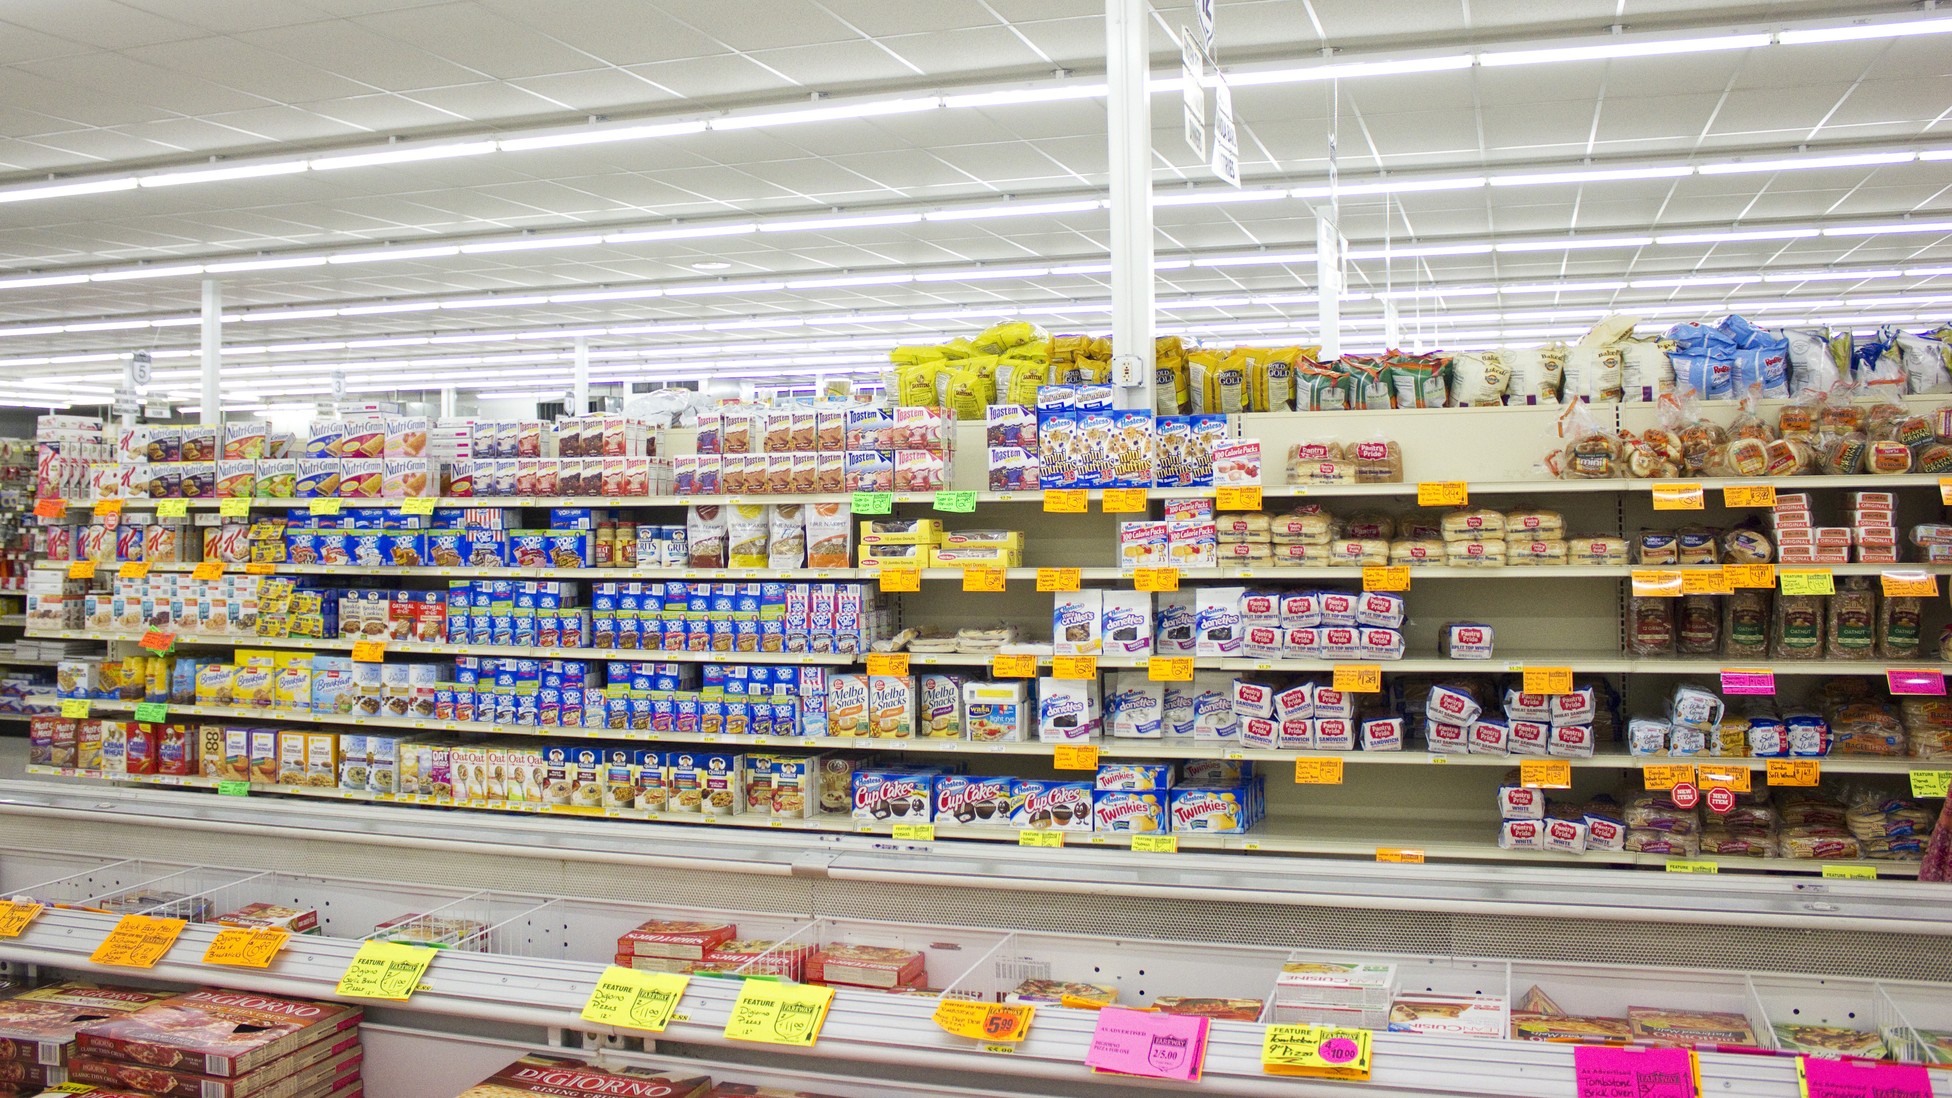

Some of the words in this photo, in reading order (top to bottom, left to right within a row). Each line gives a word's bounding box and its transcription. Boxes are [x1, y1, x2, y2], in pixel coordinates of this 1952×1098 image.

[138, 366, 146, 378] 5
[1268, 368, 1291, 377] GOLD
[1065, 375, 1083, 383] GOLD
[1220, 377, 1243, 386] GOLD
[1046, 420, 1070, 432] Hostess
[1084, 419, 1109, 430] Hostess
[1122, 417, 1146, 429] Hostess
[1161, 424, 1185, 436] Hostess
[1045, 450, 1066, 463] mini
[1082, 449, 1103, 463] mini
[1119, 449, 1141, 463] mini
[1160, 453, 1181, 466] mini
[1214, 452, 1225, 460] 100
[1225, 449, 1242, 458] Calorie
[1041, 460, 1076, 475] muffins
[1078, 460, 1114, 474] muffins
[1115, 459, 1152, 474] muffins
[1157, 463, 1191, 478] muffins
[1169, 505, 1179, 513] 100
[1178, 503, 1195, 512] Calorie
[1123, 533, 1132, 541] 100
[1132, 530, 1149, 539] Calorie
[1171, 533, 1181, 541] 100
[1180, 530, 1198, 539] Calorie
[1371, 599, 1389, 607] Pantry
[1371, 603, 1387, 611] Pride
[1107, 615, 1144, 630] donettes
[1201, 615, 1239, 629] donettes
[1254, 631, 1272, 639] Pantry
[200, 671, 230, 685] Breakfast
[237, 673, 268, 687] Breakfast
[278, 675, 308, 689] Breakfast
[316, 677, 351, 692] Breakfast
[831, 687, 864, 703] Melba
[872, 687, 906, 704] Melba
[924, 686, 955, 703] Melba
[836, 696, 866, 709] Snacks
[877, 696, 907, 710] Snacks
[928, 695, 957, 709] Snacks
[1120, 698, 1156, 711] donettes
[1236, 700, 1263, 710] SANDWICH
[1047, 703, 1084, 717] donettes
[1285, 703, 1312, 716] SANDWICH
[205, 731, 219, 741] CO
[1244, 734, 1272, 744] SANDWICH
[205, 741, 219, 751] CO
[452, 752, 468, 762] Oat
[469, 753, 485, 763] Oat
[489, 753, 505, 762] Oat
[508, 754, 525, 763] Oat
[527, 756, 544, 765] Oat
[1187, 762, 1221, 776] Twinkies
[858, 776, 882, 787] Hostess
[1100, 771, 1135, 786] Twinkies
[1097, 802, 1148, 824] Twinkies
[1174, 801, 1227, 823] Twinkies
[1553, 838, 1571, 846] WHITE
[1592, 837, 1610, 846] WHITE
[357, 958, 386, 966] FEATURE
[1284, 974, 1349, 984] CUISINE
[602, 983, 633, 993] FEATURE
[67, 989, 149, 1002] DIGIORNO
[189, 991, 321, 1017] DIGIORNO
[743, 998, 775, 1007] FEATURE
[229, 1008, 253, 1016] THIN
[1110, 1028, 1147, 1037] ADVERTISED
[1274, 1027, 1312, 1036] FEATURE
[1154, 1036, 1186, 1047] FAREWAY
[1153, 1049, 1178, 1060] 2/5.00
[515, 1068, 672, 1097] DIGIORNO
[1584, 1078, 1632, 1087] Tombstone
[530, 1085, 580, 1098] RISING
[1584, 1089, 1607, 1098] Brick
[1611, 1088, 1633, 1097] Oven
